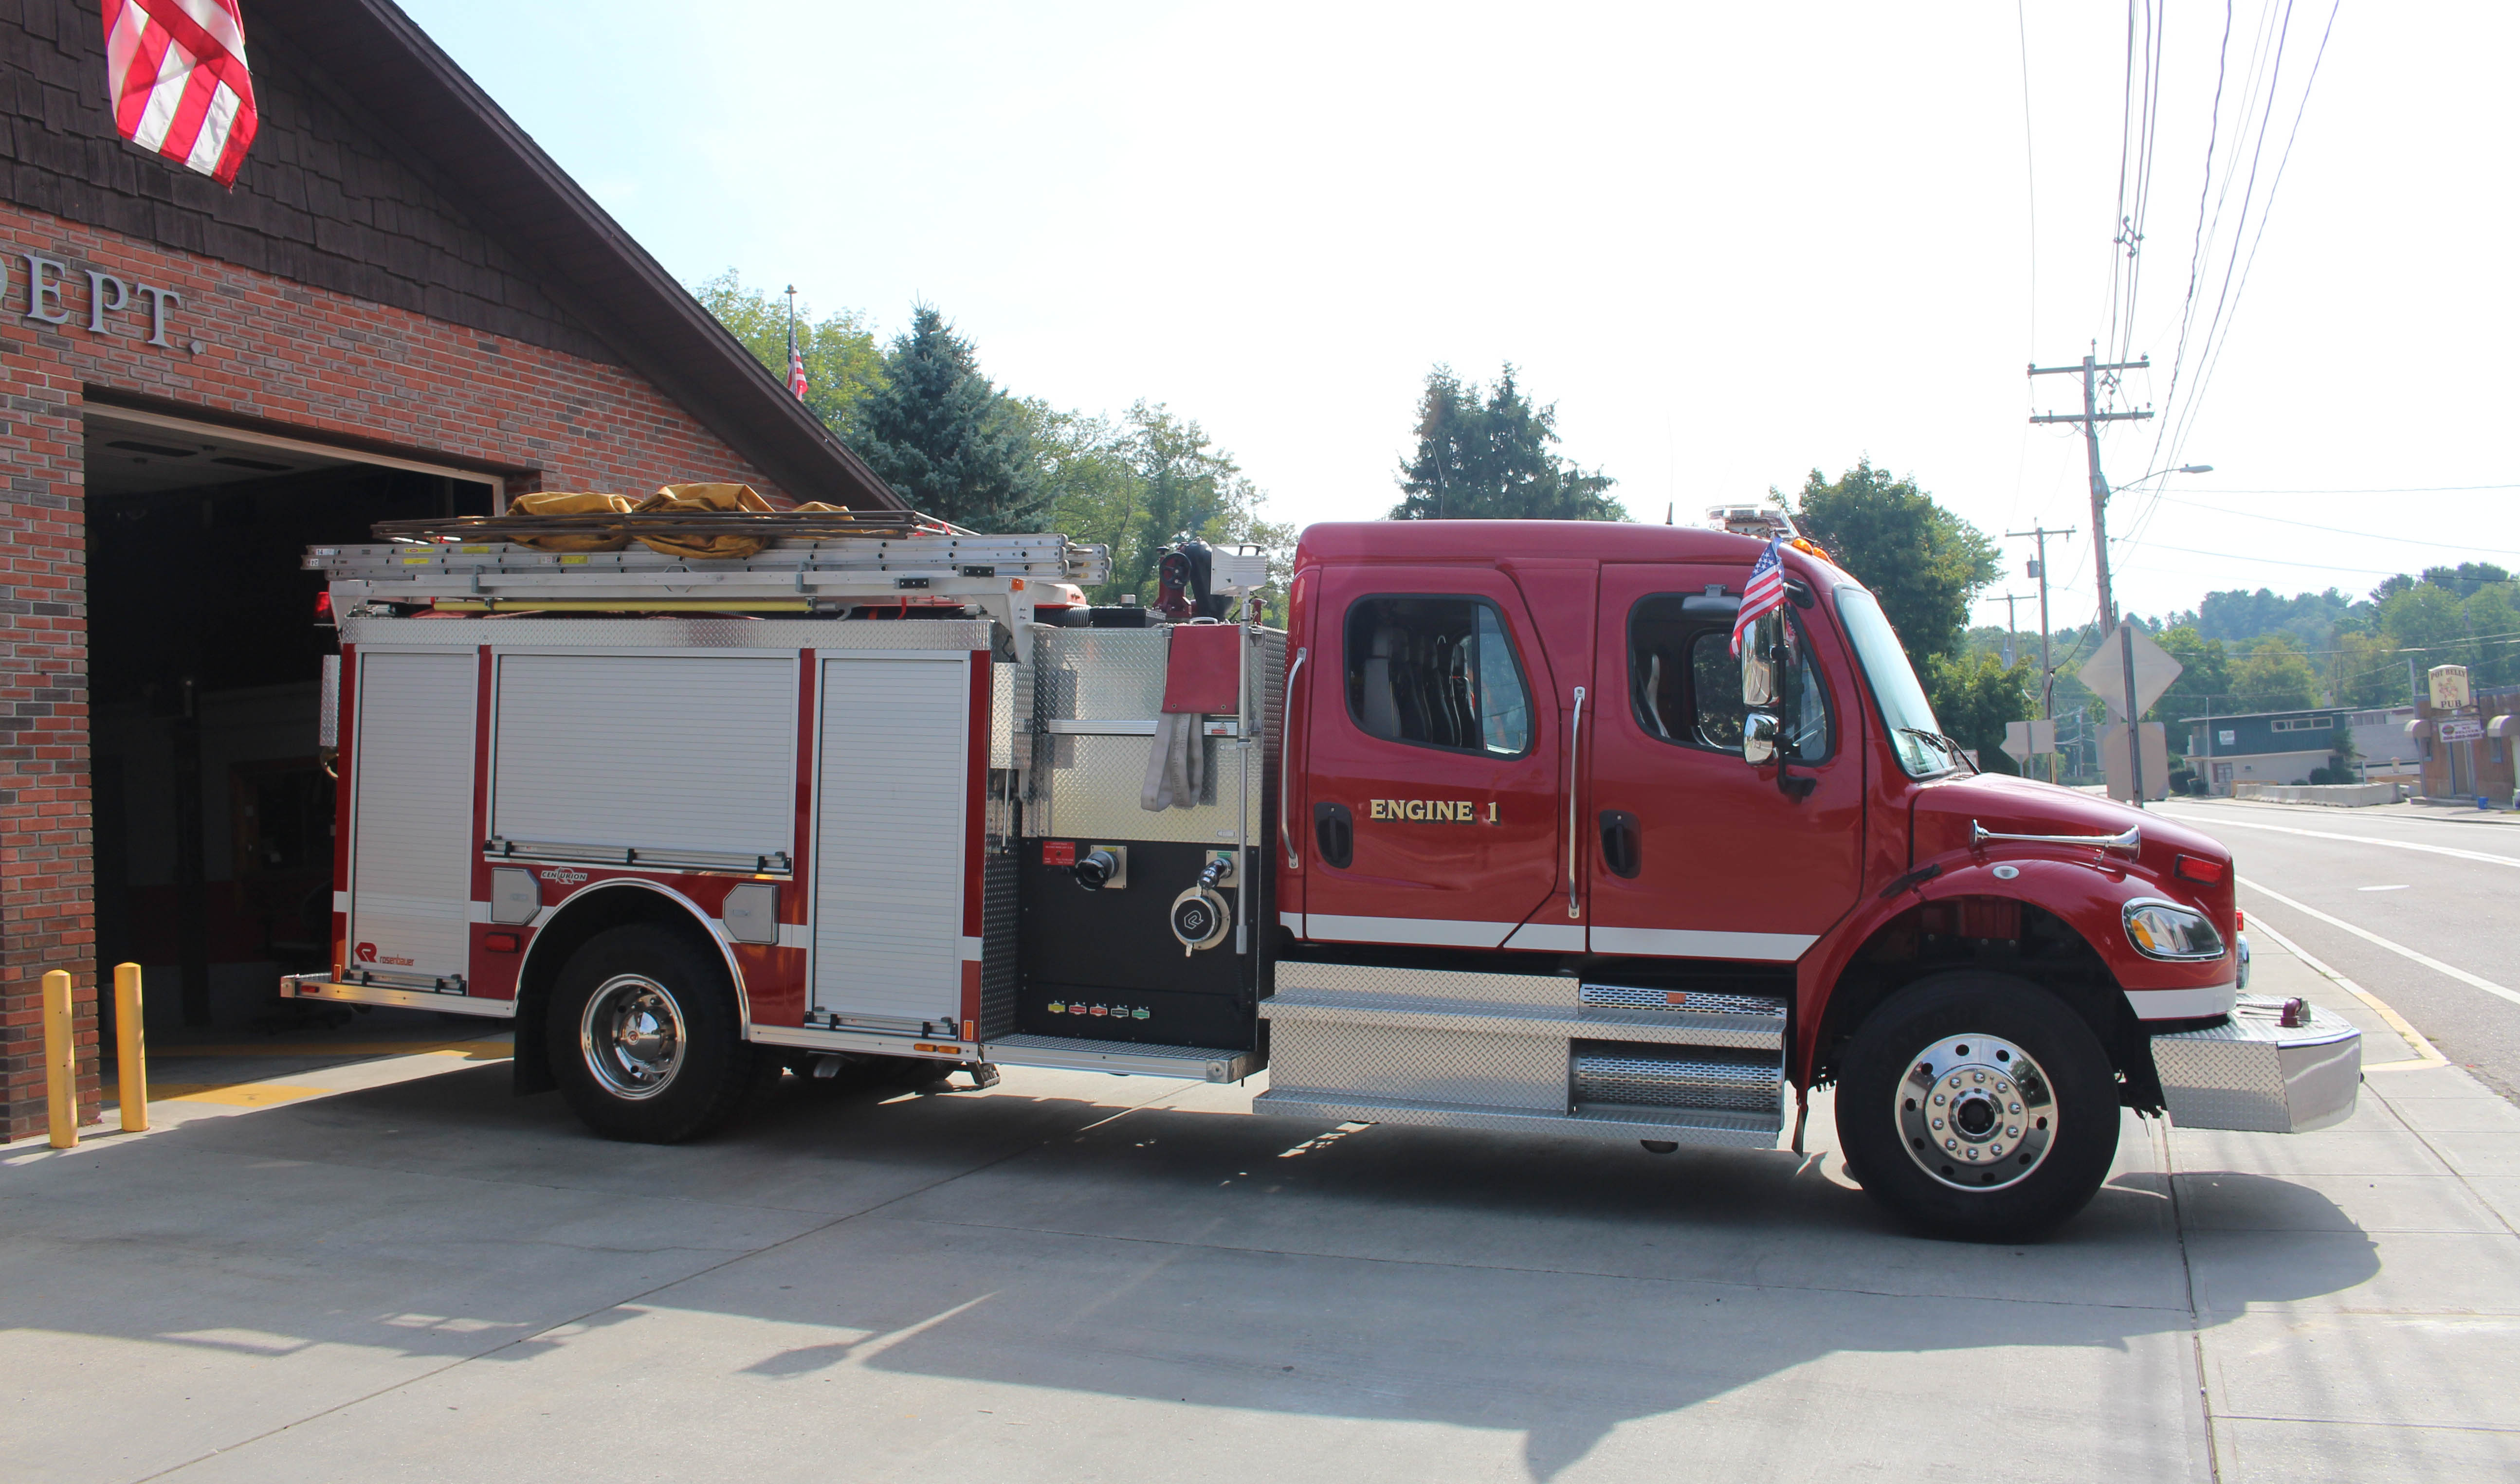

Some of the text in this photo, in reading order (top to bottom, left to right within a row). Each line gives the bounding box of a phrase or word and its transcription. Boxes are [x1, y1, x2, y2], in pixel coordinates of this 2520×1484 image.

[0, 253, 202, 355] EPT.
[2430, 669, 2465, 680] POT BELLY
[2441, 700, 2461, 708] PUB
[1370, 799, 1499, 823] ENGINE 1
[542, 870, 586, 881] CENTURION
[380, 954, 415, 966] rosenbauer
